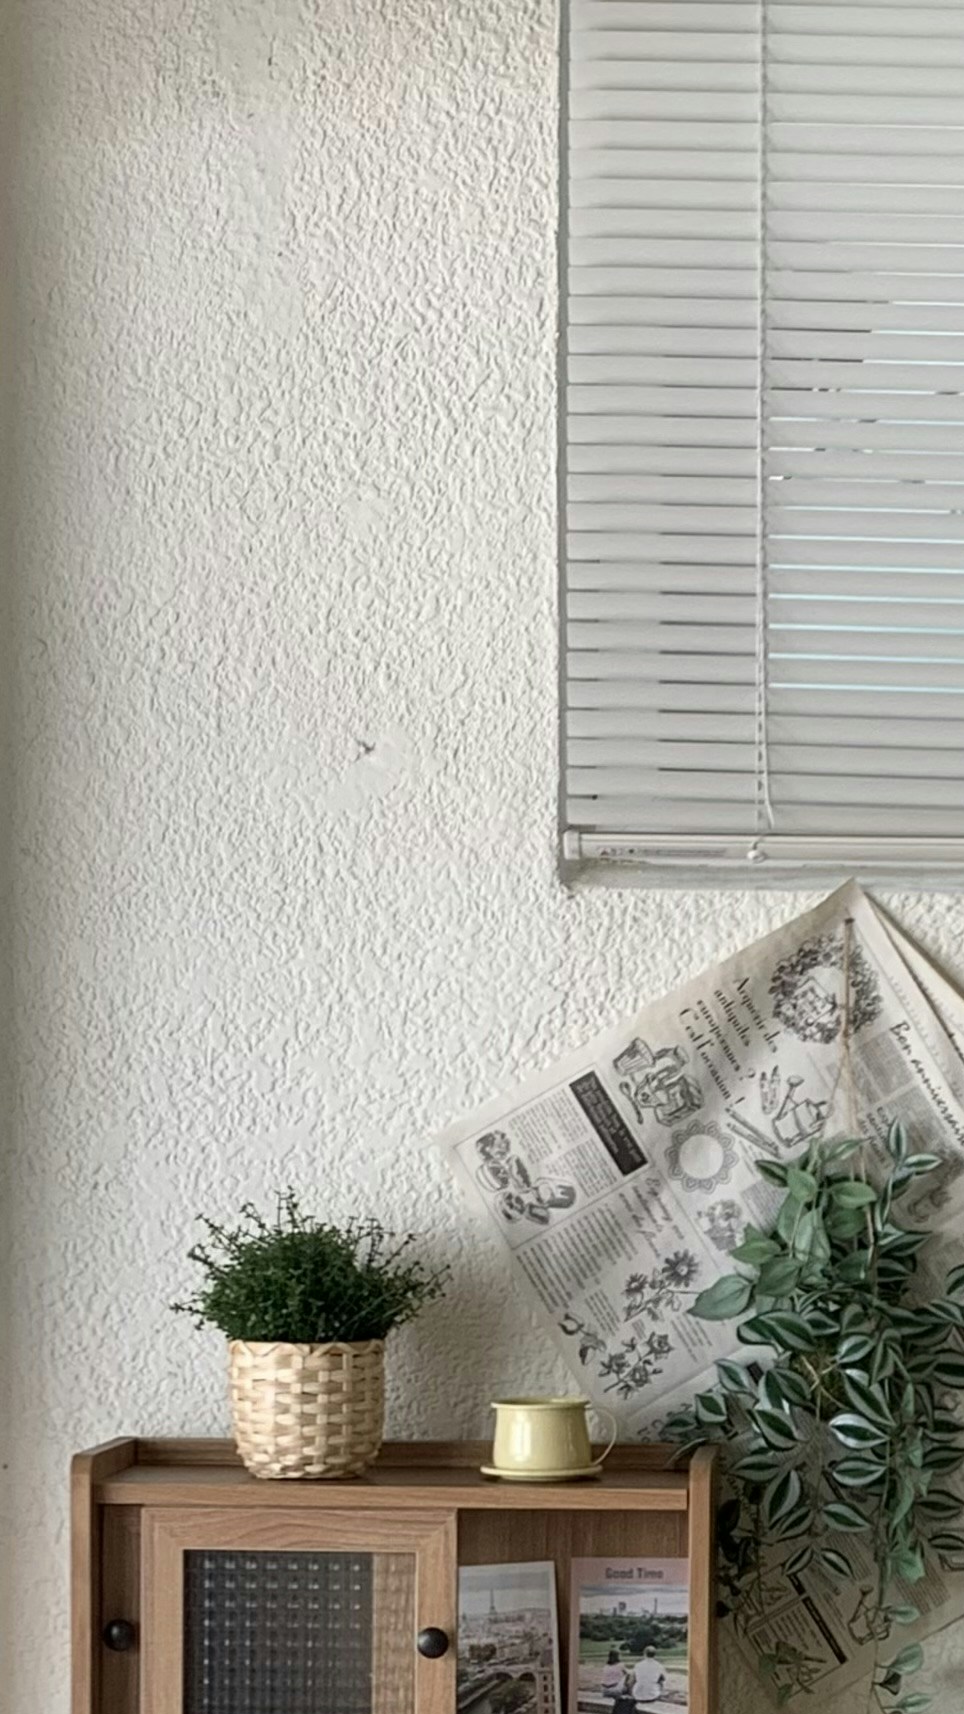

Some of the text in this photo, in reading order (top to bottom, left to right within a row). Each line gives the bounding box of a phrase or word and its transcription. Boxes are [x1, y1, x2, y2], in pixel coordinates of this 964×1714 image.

[889, 1020, 912, 1055] Bon
[605, 1567, 664, 1579] Good Time
